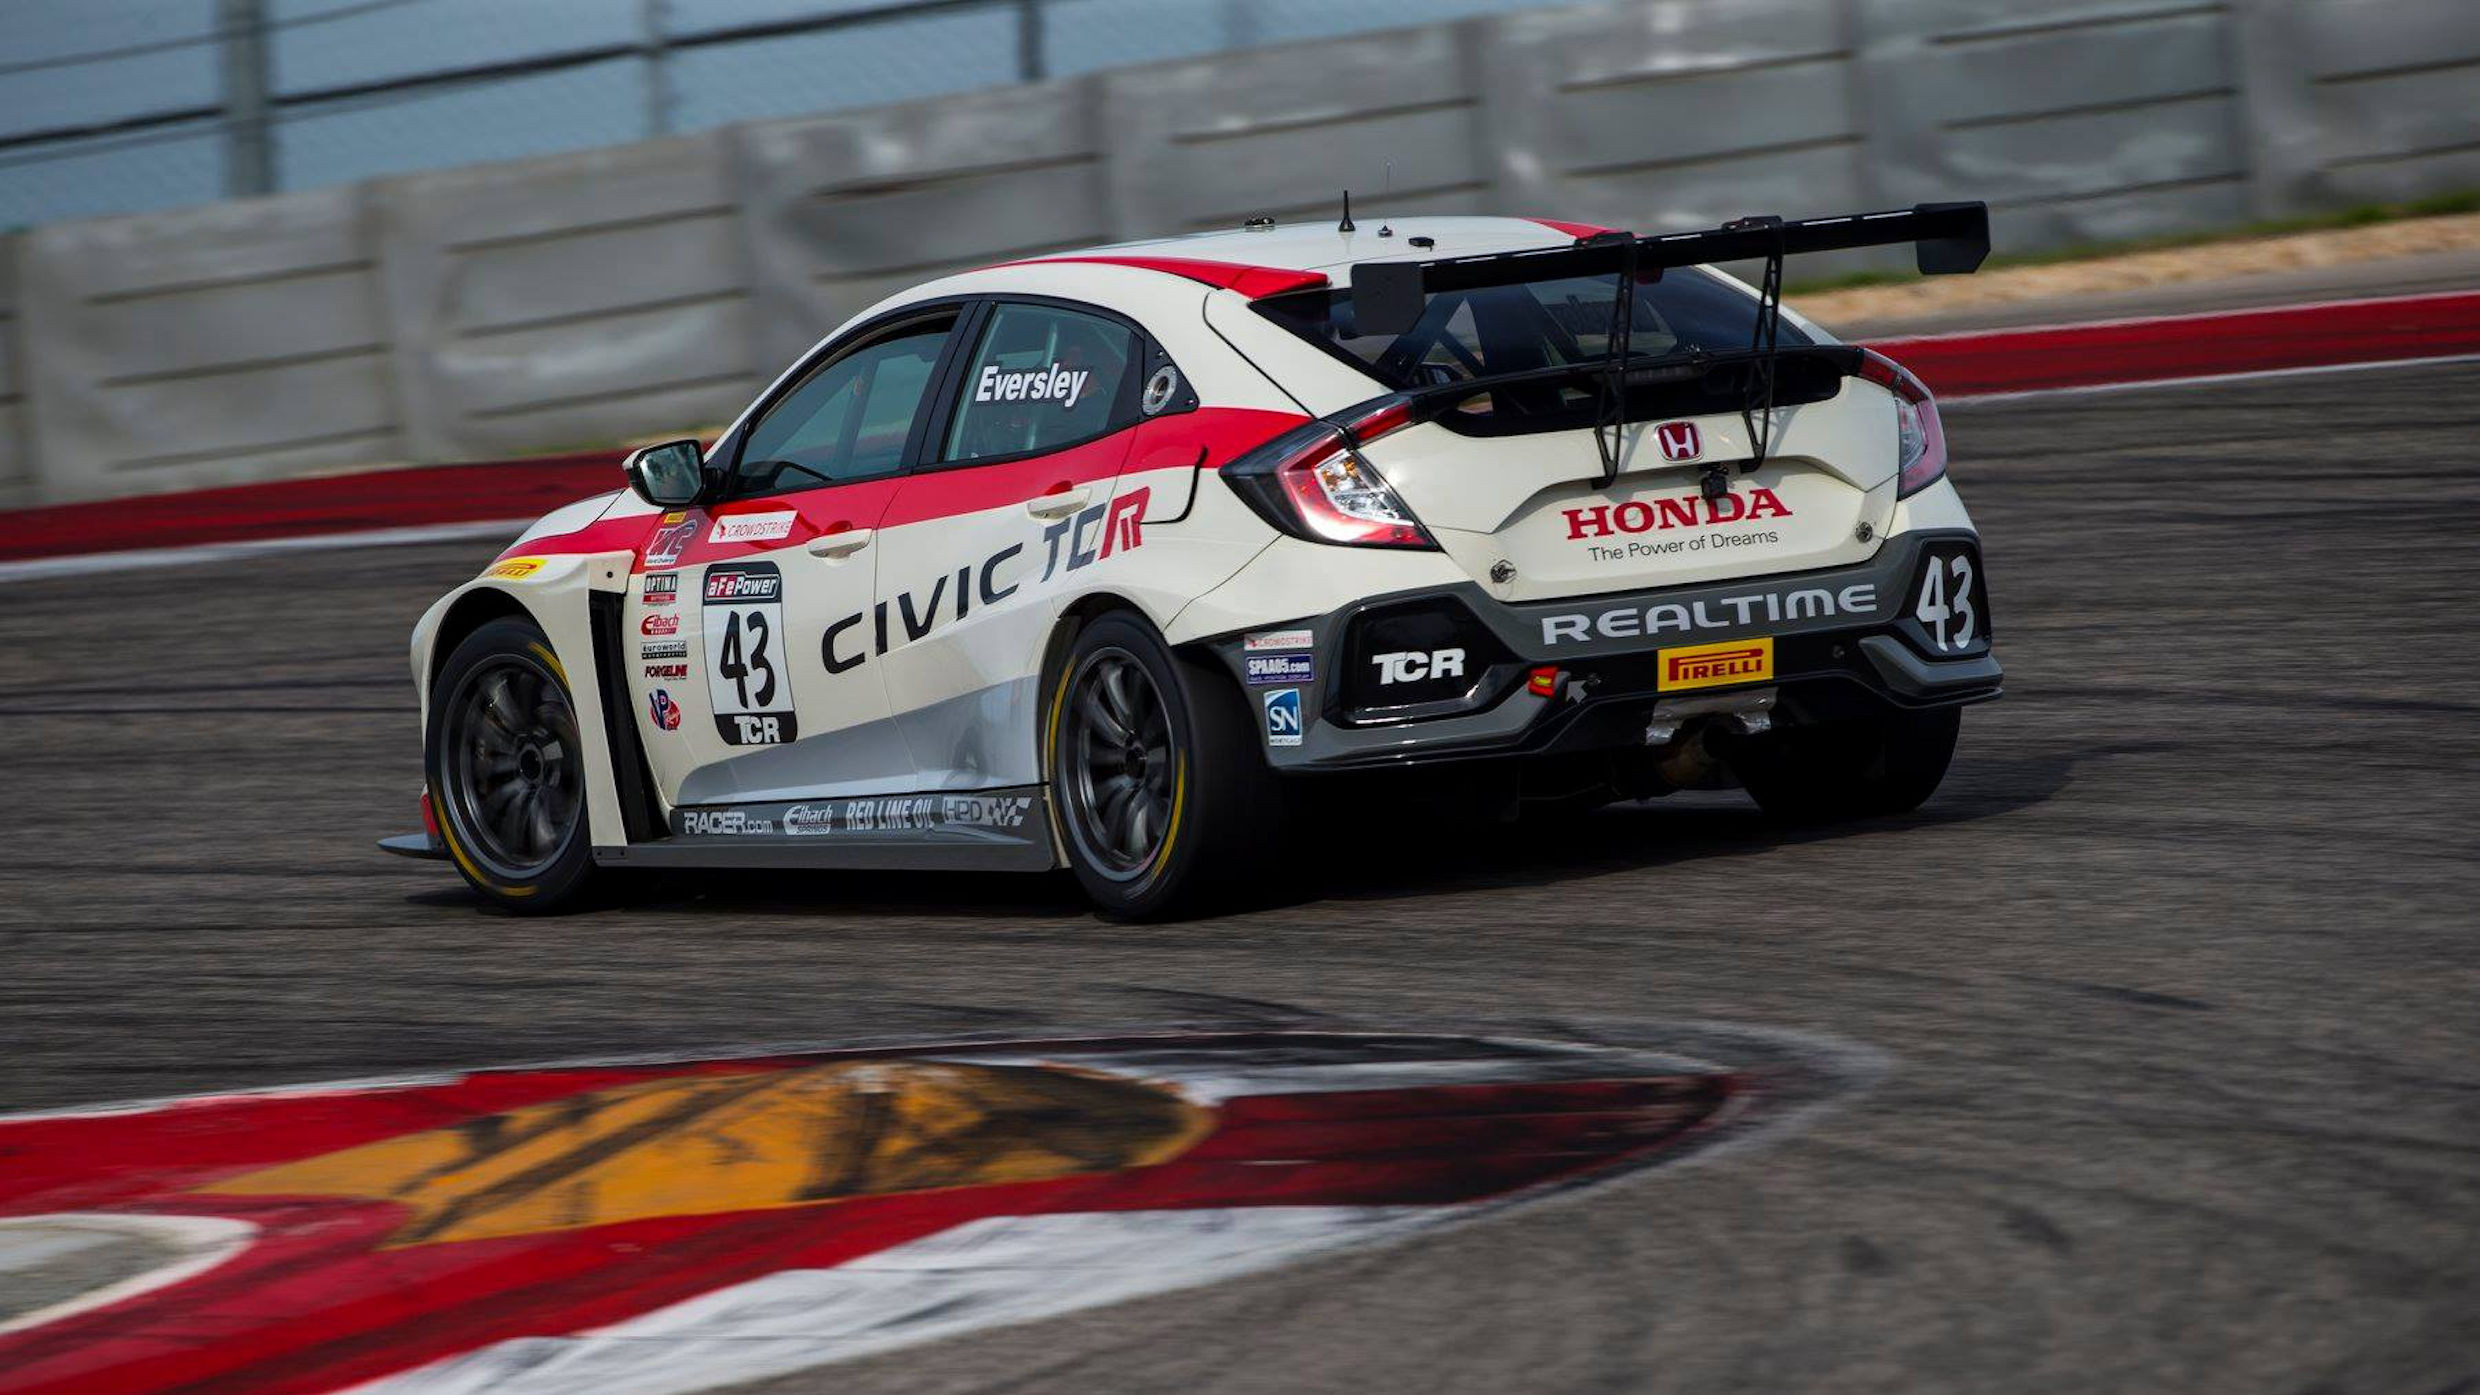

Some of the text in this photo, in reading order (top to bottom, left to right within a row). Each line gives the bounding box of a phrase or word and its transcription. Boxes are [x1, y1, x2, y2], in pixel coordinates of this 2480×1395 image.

[975, 363, 1089, 407] Eversley
[1562, 488, 1793, 541] HONDA
[1588, 530, 1778, 562] The Power of Dreams
[645, 576, 676, 592] OPTIMA
[821, 486, 1150, 674] CIVIC TCR
[1542, 583, 1878, 645] REALTIME
[1916, 555, 1975, 653] 43
[720, 610, 775, 709] 43
[1373, 648, 1466, 685] TCR
[1669, 648, 1763, 682] PIRELLI
[734, 715, 780, 743] TCR
[1269, 706, 1299, 731] SN
[684, 810, 773, 834] RACER.com
[783, 804, 832, 835] Eibach
[846, 798, 935, 830] RED LINE OIL
